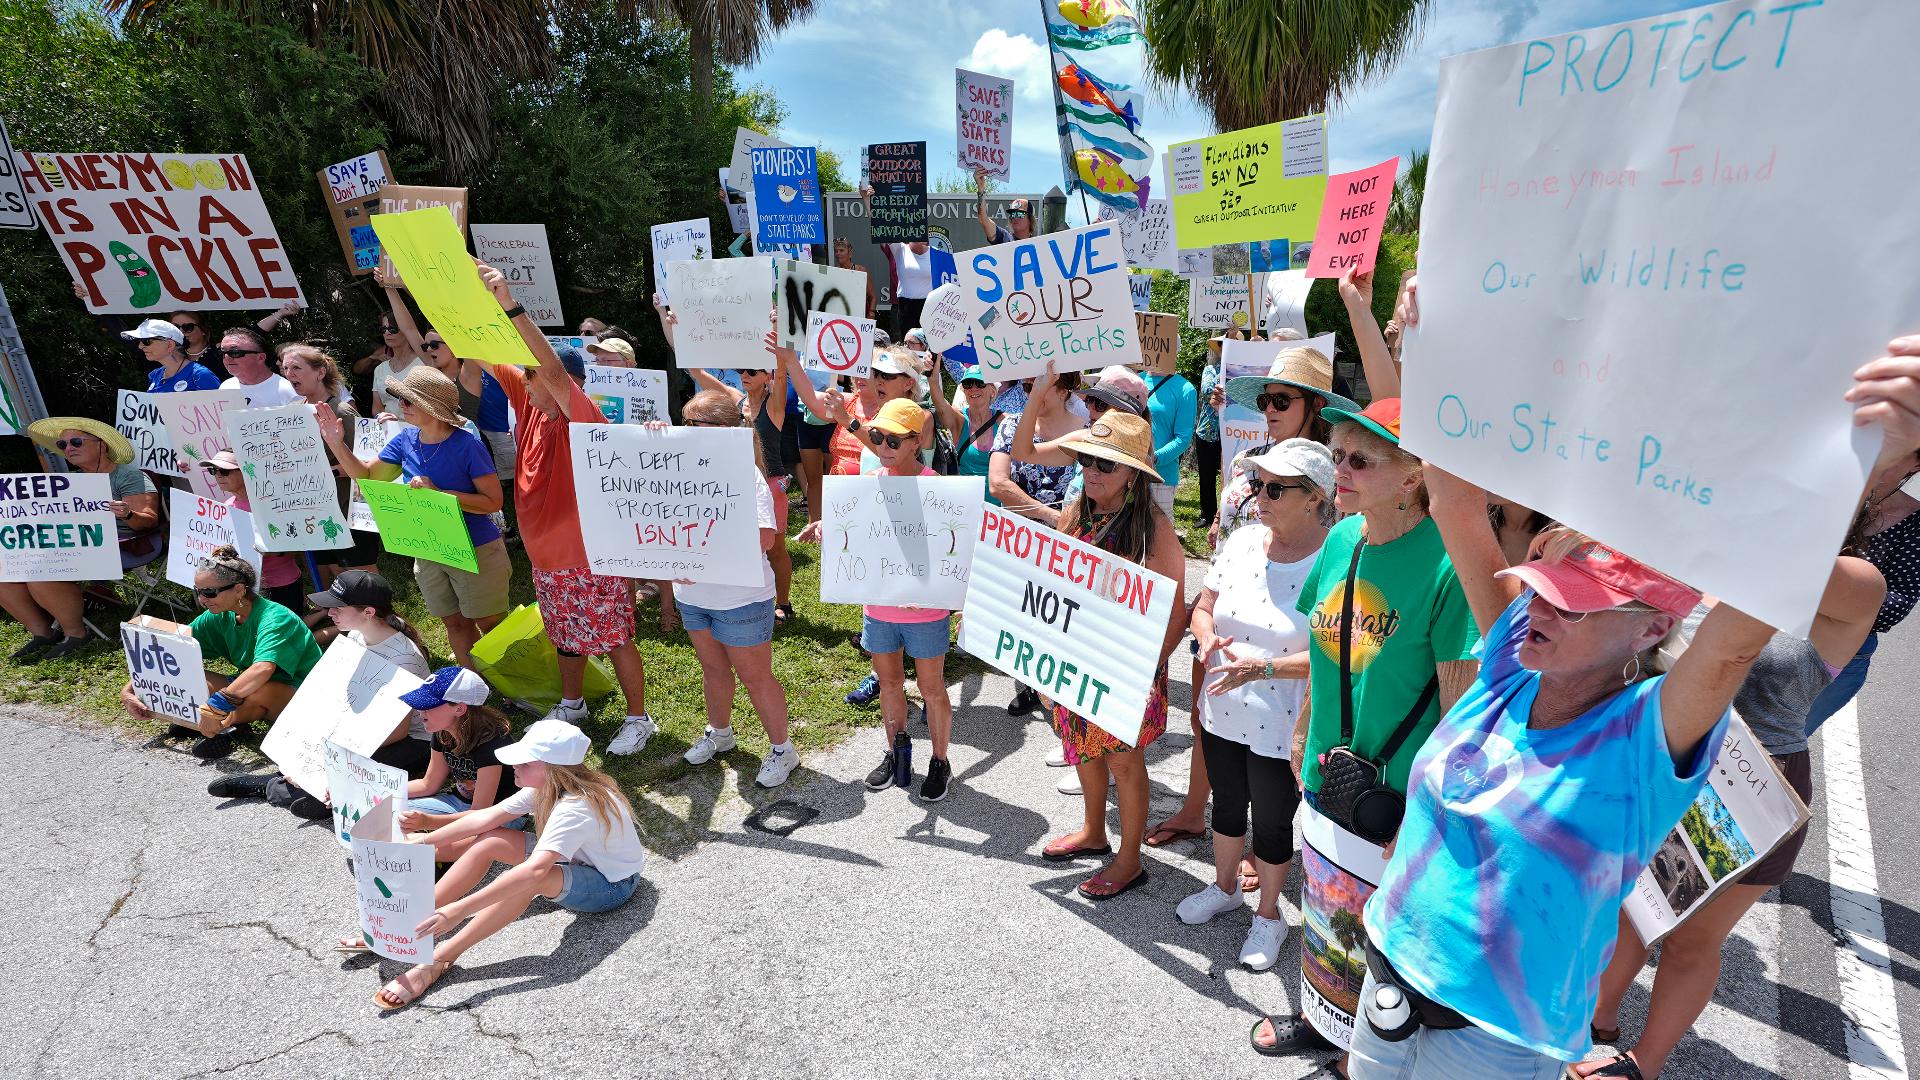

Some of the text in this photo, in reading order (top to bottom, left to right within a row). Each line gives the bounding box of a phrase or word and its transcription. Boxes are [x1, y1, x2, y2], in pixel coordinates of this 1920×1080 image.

[1518, 0, 1825, 107] PROTECT
[969, 85, 1000, 108] SAVE
[970, 108, 992, 125] OUR
[962, 121, 999, 145] STATE
[875, 144, 917, 156] GREAT
[968, 144, 1004, 166] PARKS
[1205, 140, 1269, 166] Floridians
[329, 158, 369, 185] SAVE
[752, 149, 811, 177] PLOVERS!
[869, 159, 922, 171] OUTDOOR
[1211, 162, 1260, 187] SAY NO
[1660, 144, 1778, 187] Island
[869, 171, 922, 183] INITIATIVE
[1347, 175, 1380, 196] NOT
[871, 194, 919, 206] GREEDY
[1220, 195, 1242, 211] DEP
[1339, 201, 1377, 221] HERE
[38, 198, 94, 235] IS
[110, 196, 180, 235] IN
[198, 195, 253, 237] A
[872, 208, 926, 224] OPPORTUNIST
[1193, 202, 1298, 224] GREAT OUTDOOR INITIATIVE
[476, 235, 540, 250] PICKLEBALL
[654, 230, 676, 250] Fight
[684, 228, 707, 242] Those
[767, 223, 817, 239] STATE PARKS
[872, 225, 926, 238] INDIVIDUALS
[1337, 227, 1369, 246] NOT
[390, 234, 456, 283] WHO
[973, 227, 1118, 303] SAVE
[1328, 253, 1364, 269] EVER
[1481, 246, 1748, 294] Our Wildlife
[785, 276, 851, 335] NO
[1006, 276, 1104, 325] OUR
[1215, 300, 1247, 311] NOT
[1202, 312, 1230, 323] SOUR
[983, 331, 1055, 370] State
[1056, 322, 1125, 356] Parks
[589, 368, 613, 384] Don't
[1552, 353, 1612, 384] and
[122, 393, 166, 426] Sav
[178, 400, 230, 435] SAV
[117, 423, 140, 441] our
[240, 415, 305, 436] STATE PARKS
[588, 429, 608, 443] THE
[1225, 426, 1260, 441] DONT
[291, 435, 317, 450] LAND
[1436, 394, 1714, 506] Our State Parks
[586, 448, 711, 472] FLA. DEPT. OF
[0, 475, 70, 500] KEEP
[255, 472, 326, 498] NO HUMAN
[600, 475, 741, 498] ENVIRONMENTAL
[0, 496, 110, 519] RIDA STATE PARKS
[196, 497, 227, 521] STOP
[405, 489, 454, 520] FLORIDA
[832, 490, 964, 519] KEEP OUR PARKS
[0, 523, 104, 551] GREEN
[868, 520, 938, 540] NATURAL
[835, 558, 969, 584] NO PICKLE BALL
[979, 509, 1155, 616] PROTECTION
[1020, 579, 1081, 634] NOT
[121, 628, 181, 676] Vote
[994, 629, 1111, 716] PROFIT
[132, 671, 186, 699] Save our
[146, 693, 199, 723] Planet
[1722, 735, 1768, 797] about
[1318, 996, 1354, 1028] Paradi
